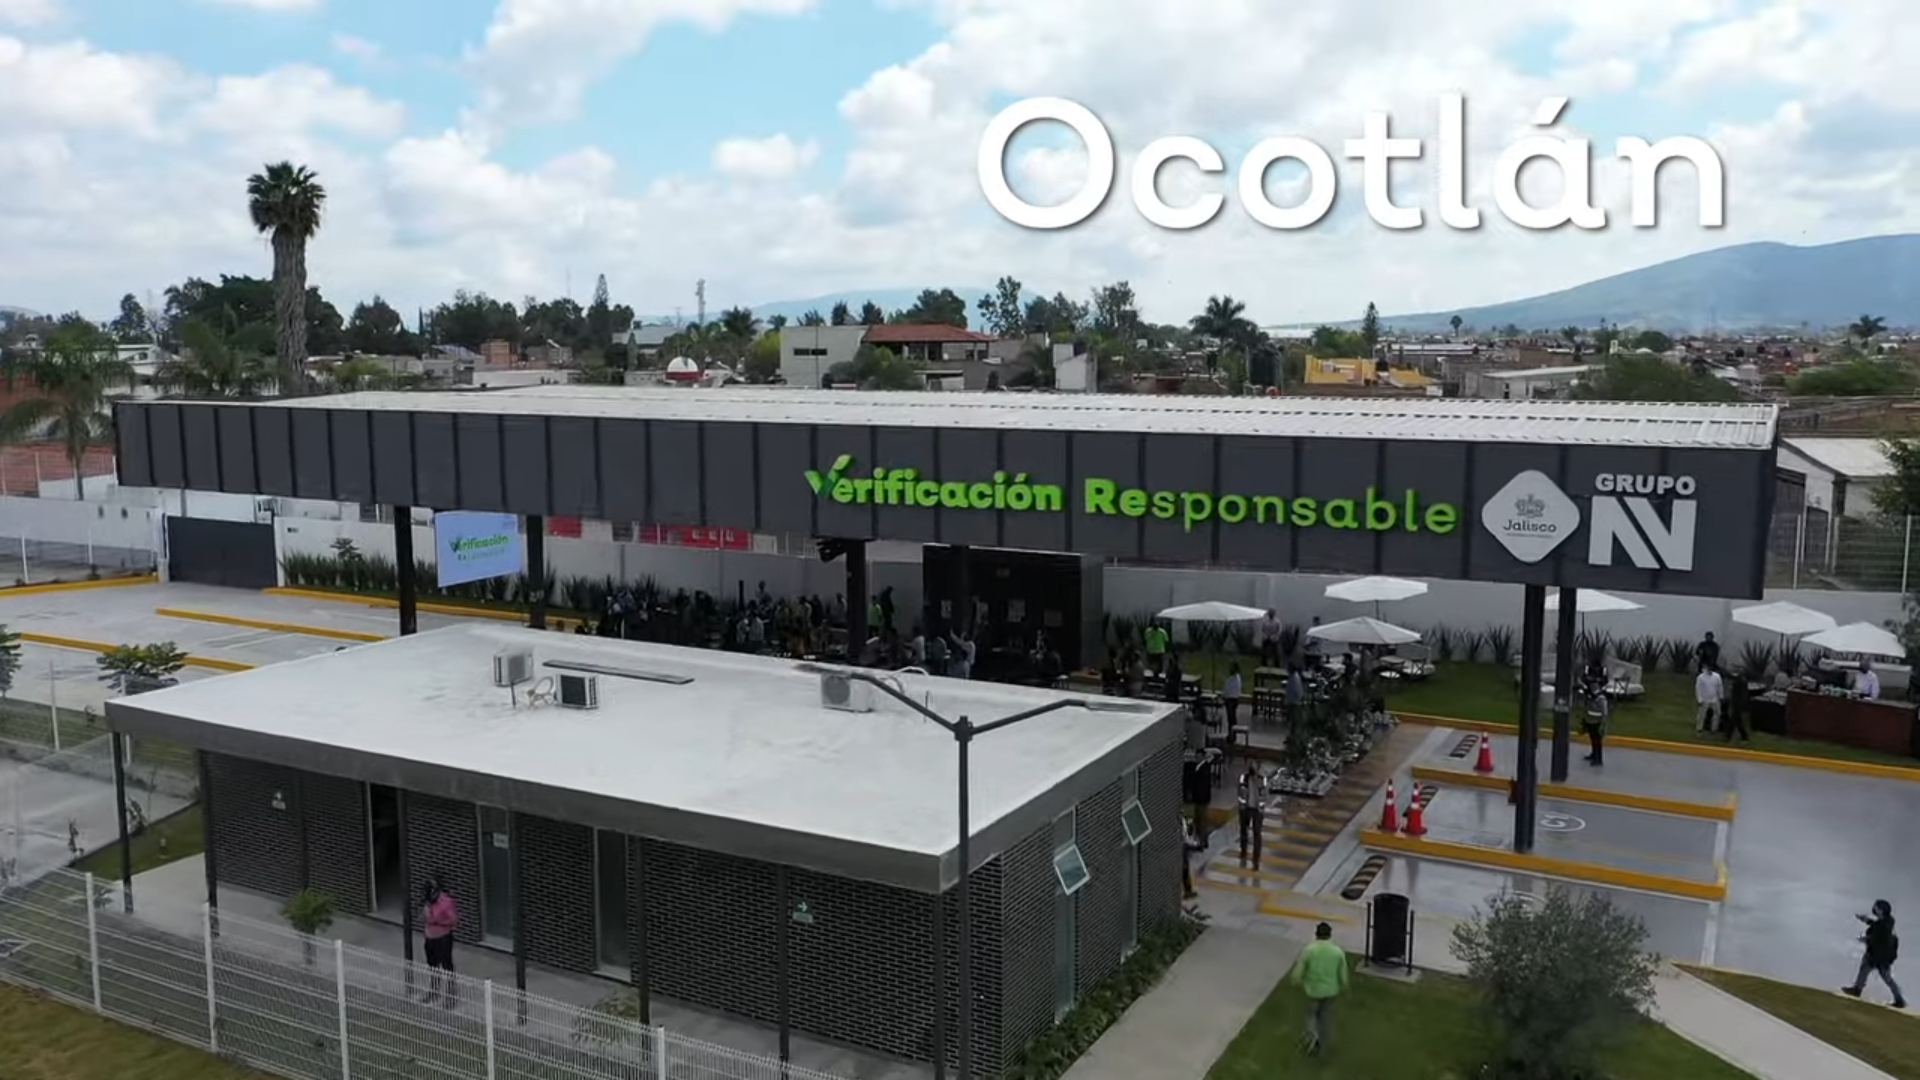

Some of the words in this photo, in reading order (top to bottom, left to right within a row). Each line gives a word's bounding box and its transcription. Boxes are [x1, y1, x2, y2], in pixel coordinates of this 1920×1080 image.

[804, 454, 1063, 511] Verificación
[1084, 476, 1457, 534] Responsable
[1595, 473, 1696, 495] GRUPO
[1503, 519, 1557, 533] Jalisco
